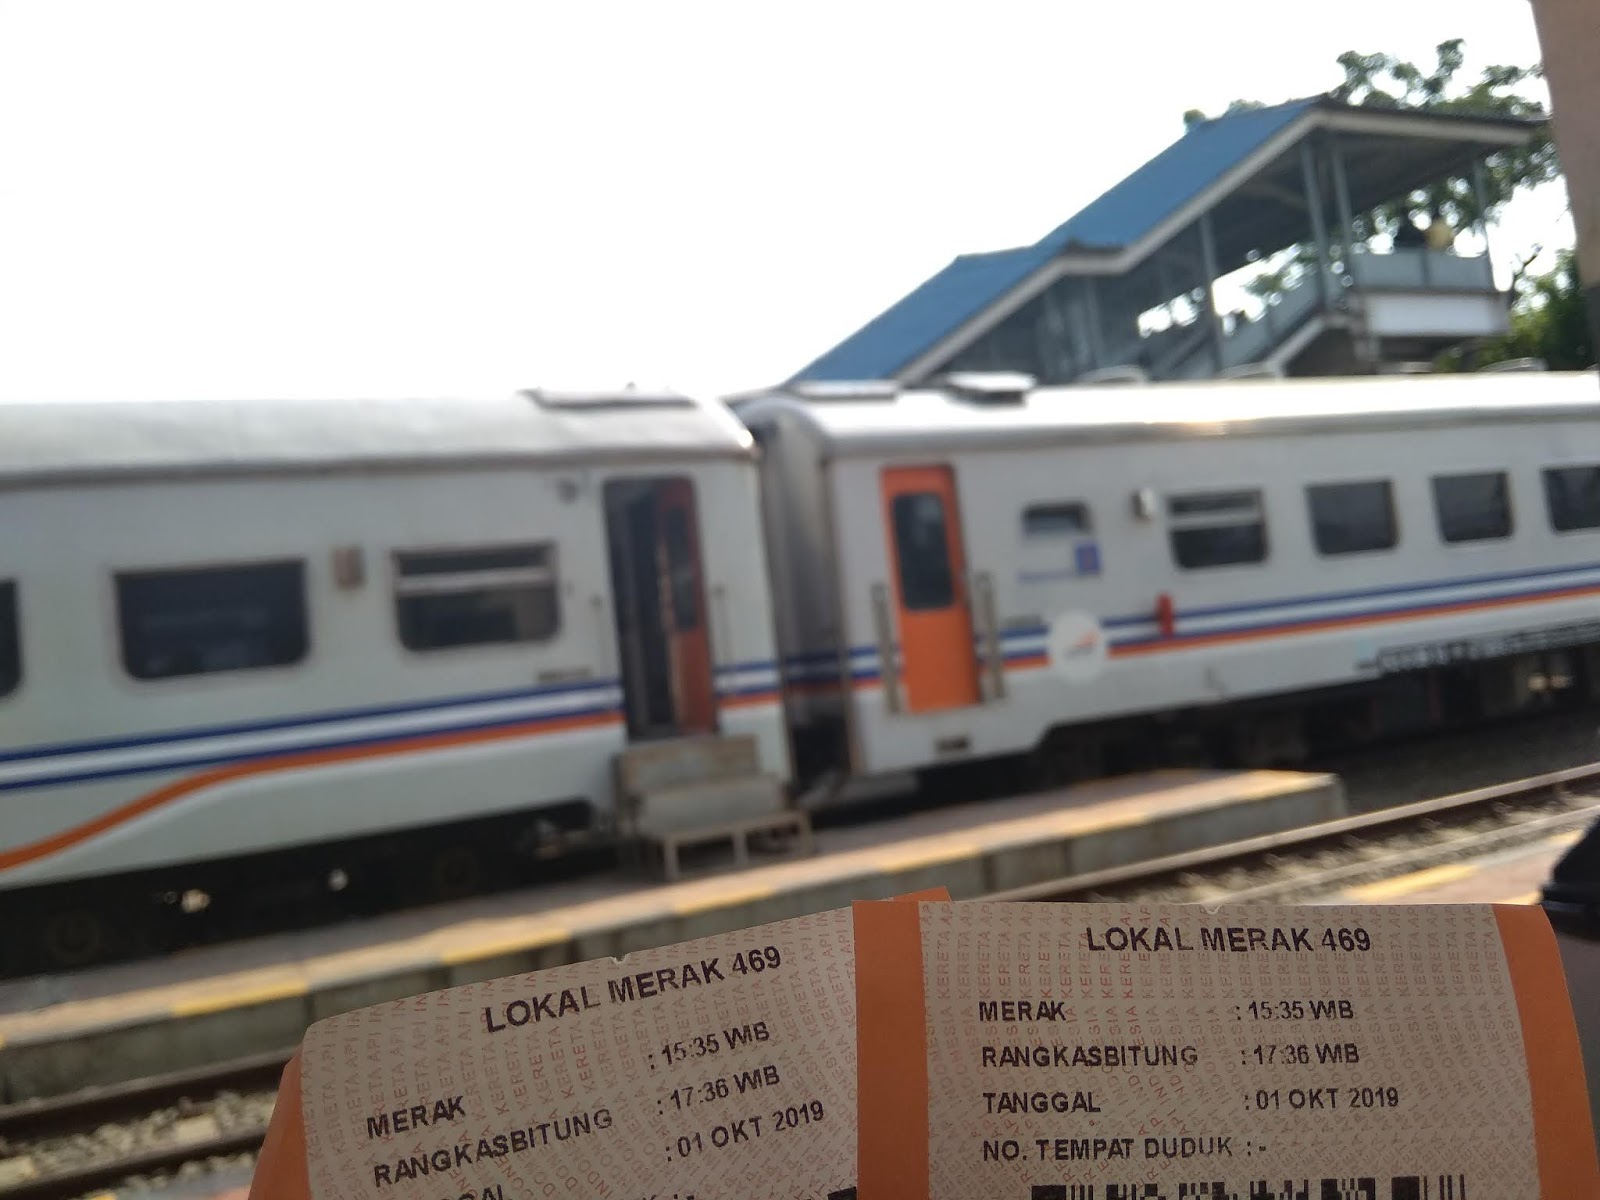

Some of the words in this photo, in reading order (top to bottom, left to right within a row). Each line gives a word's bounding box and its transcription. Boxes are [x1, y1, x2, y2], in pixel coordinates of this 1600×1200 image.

[1086, 927, 1194, 951] LOKAL
[1200, 927, 1314, 952] MERAK
[1321, 927, 1371, 951] 469
[485, 986, 601, 1033] LOKAL
[608, 958, 725, 1004] MERAK
[732, 945, 782, 976] 469
[978, 1000, 1067, 1021] MERAK
[1248, 1000, 1304, 1020] 15:35
[1309, 1000, 1354, 1020] WIB
[982, 1046, 1198, 1067] RANGKASBITUNG
[1253, 1044, 1310, 1065] 17:36
[1315, 1043, 1360, 1064] WIB
[367, 1095, 466, 1140] MERAK
[661, 1033, 720, 1065] 15:35
[723, 1021, 770, 1050] WIB
[982, 1092, 1101, 1113] TANGGAL
[1256, 1089, 1280, 1110] 01
[1288, 1088, 1339, 1109] OKT
[1349, 1087, 1399, 1108] 2019
[374, 1108, 613, 1188] RANGKASBITUNG
[670, 1078, 729, 1110] 17:36
[733, 1065, 780, 1093] WIB
[677, 1132, 703, 1158] 01
[711, 1115, 762, 1148] OKT
[772, 1100, 825, 1132] 2019
[983, 1139, 1027, 1162] NO.
[1036, 1138, 1135, 1161] TEMPAT
[1145, 1136, 1234, 1159] DUDUK
